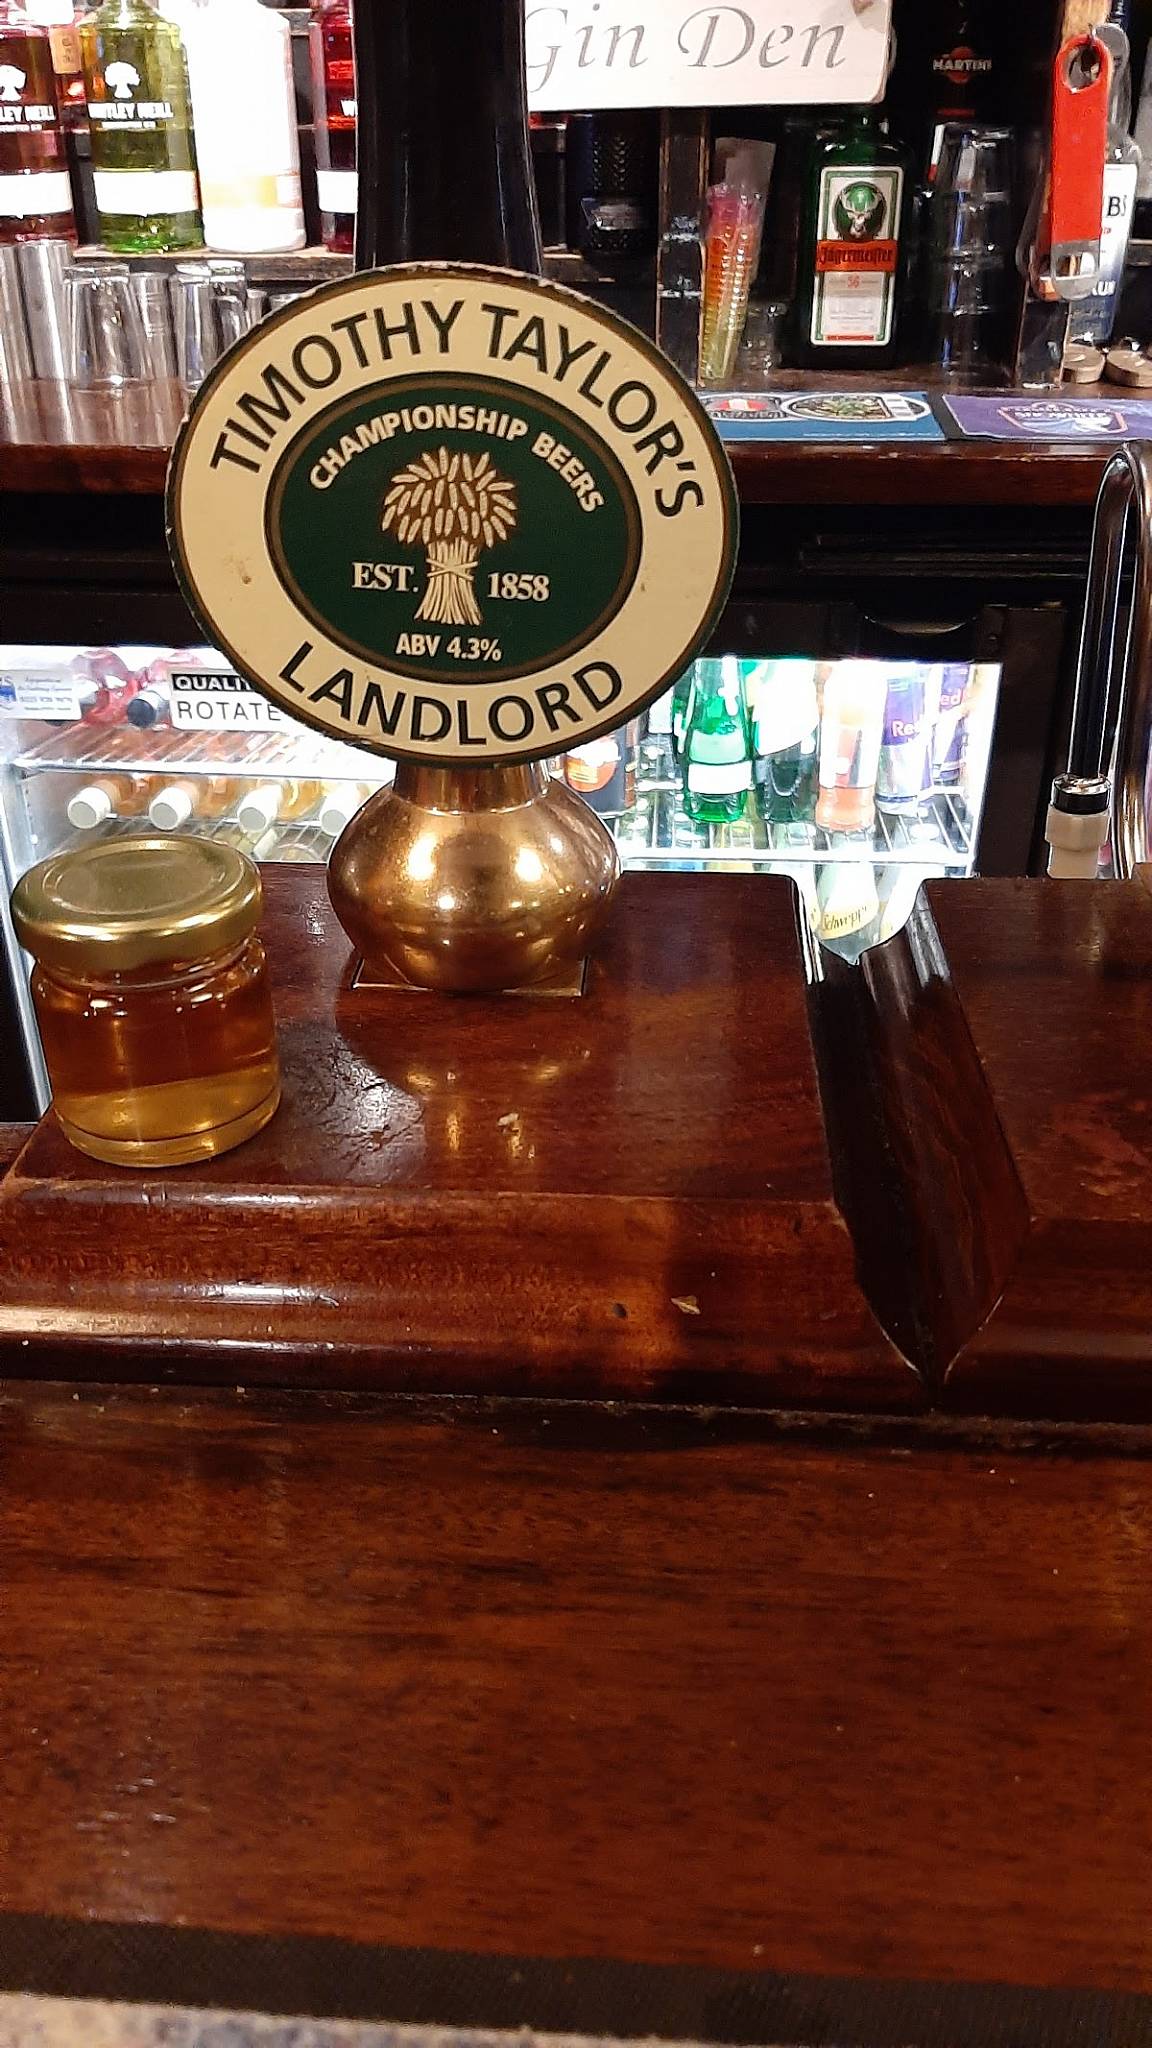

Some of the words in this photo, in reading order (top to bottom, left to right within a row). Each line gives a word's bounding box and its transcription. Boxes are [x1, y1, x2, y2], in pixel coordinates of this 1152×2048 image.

[526, 3, 648, 93] Gin
[677, 6, 846, 68] Den
[210, 300, 465, 474] TIMOTHY
[481, 304, 705, 518] TAYLOR'S
[310, 404, 529, 490] CHAMPIONSHIP
[531, 436, 605, 513] BEERS
[351, 562, 419, 593] EST.
[487, 572, 550, 602] 1858
[396, 632, 441, 658] ABV
[447, 635, 502, 662] 4.3%
[177, 701, 281, 721] ROTATE
[278, 640, 622, 746] LANDLORD
